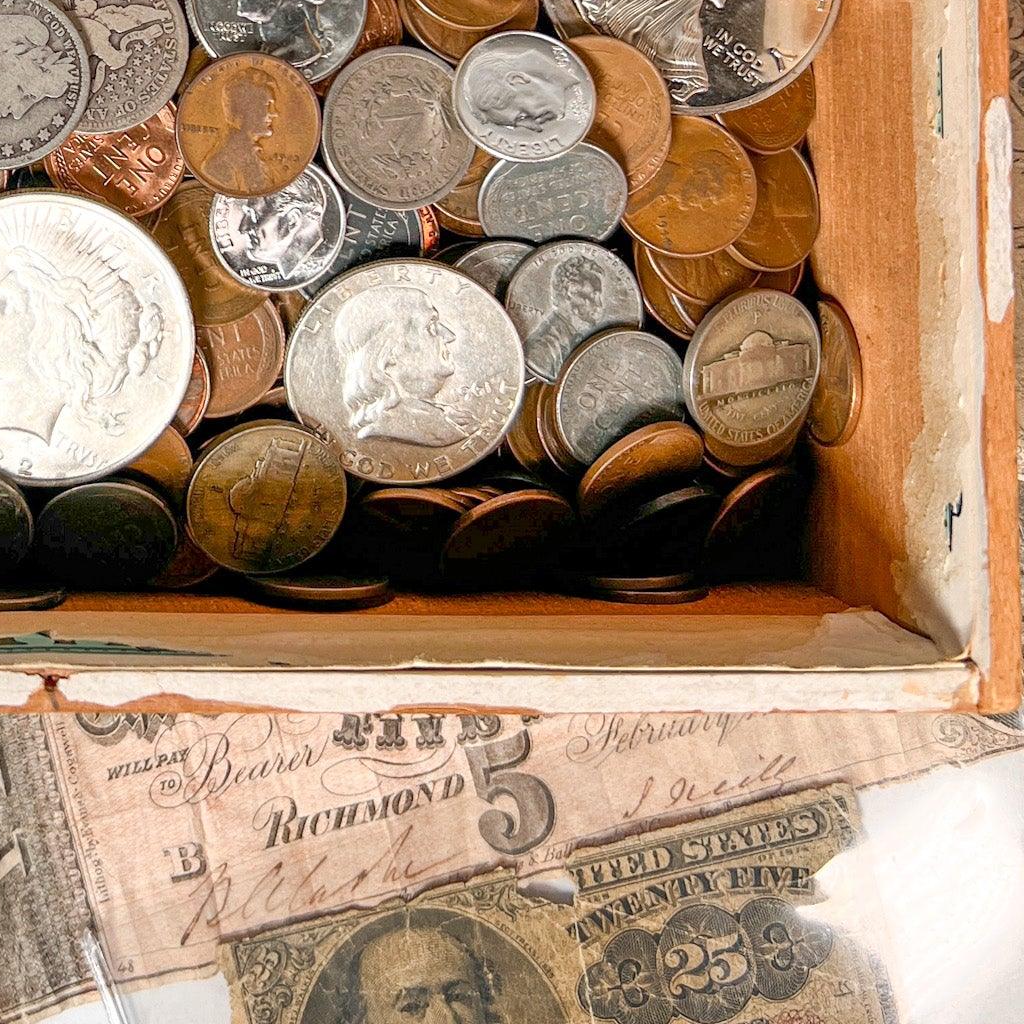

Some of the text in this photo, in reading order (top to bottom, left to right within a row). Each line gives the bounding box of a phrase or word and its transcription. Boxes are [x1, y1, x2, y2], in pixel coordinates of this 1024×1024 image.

[25, 0, 42, 17] IN
[42, 12, 67, 39] GOD
[701, 35, 766, 89] WE TRUST
[714, 25, 765, 71] IN GOD
[119, 144, 167, 196] ONE
[303, 264, 473, 334] LIBERTY
[339, 450, 395, 480] GOD
[407, 454, 453, 481] WE
[106, 746, 192, 782] WILL PAY
[159, 730, 326, 804] TO Bearer
[566, 712, 738, 769] February
[256, 773, 466, 850] RICHMOND
[463, 728, 557, 856] 5
[163, 840, 208, 884] B
[527, 851, 540, 867] &
[680, 809, 822, 863] STATES
[566, 865, 814, 945] TWENTY FIVE
[664, 932, 751, 999] 25
